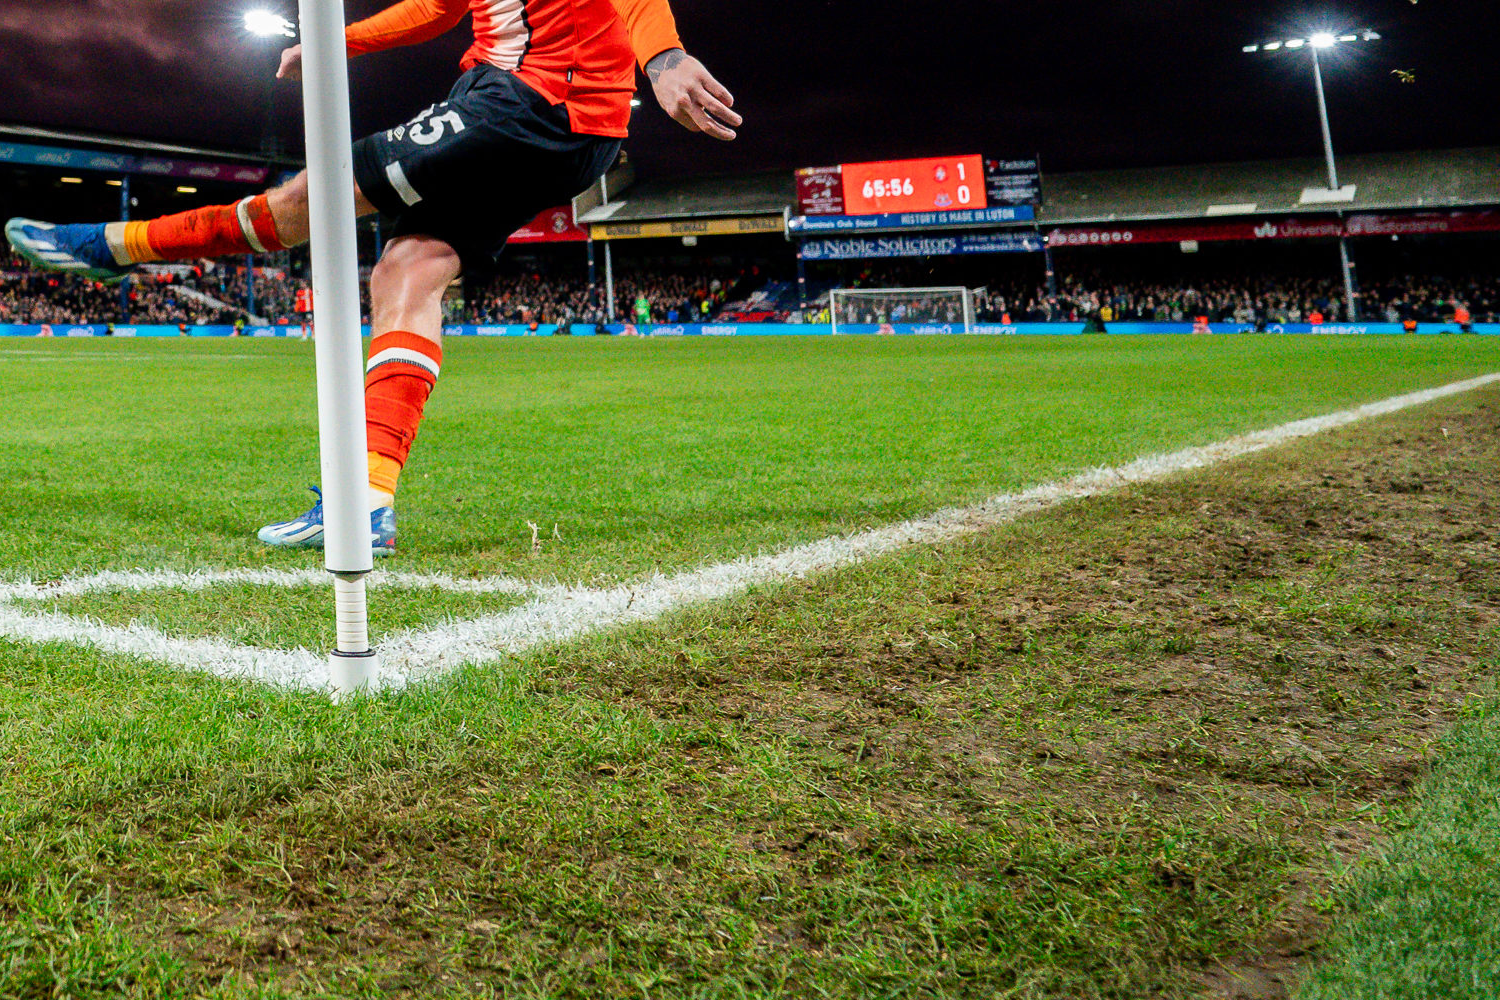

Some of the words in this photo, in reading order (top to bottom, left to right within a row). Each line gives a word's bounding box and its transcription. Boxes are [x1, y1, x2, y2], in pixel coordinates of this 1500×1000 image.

[956, 162, 966, 181] 1
[862, 178, 914, 198] 65:56
[957, 185, 970, 204] 0
[901, 212, 936, 225] HISTORY
[938, 212, 948, 223] IS
[949, 210, 973, 222] MADE
[974, 209, 985, 221] IN
[986, 207, 1015, 221] LUTON
[1279, 223, 1343, 237] University
[823, 237, 876, 255] Noble
[877, 235, 957, 253] Solicitors
